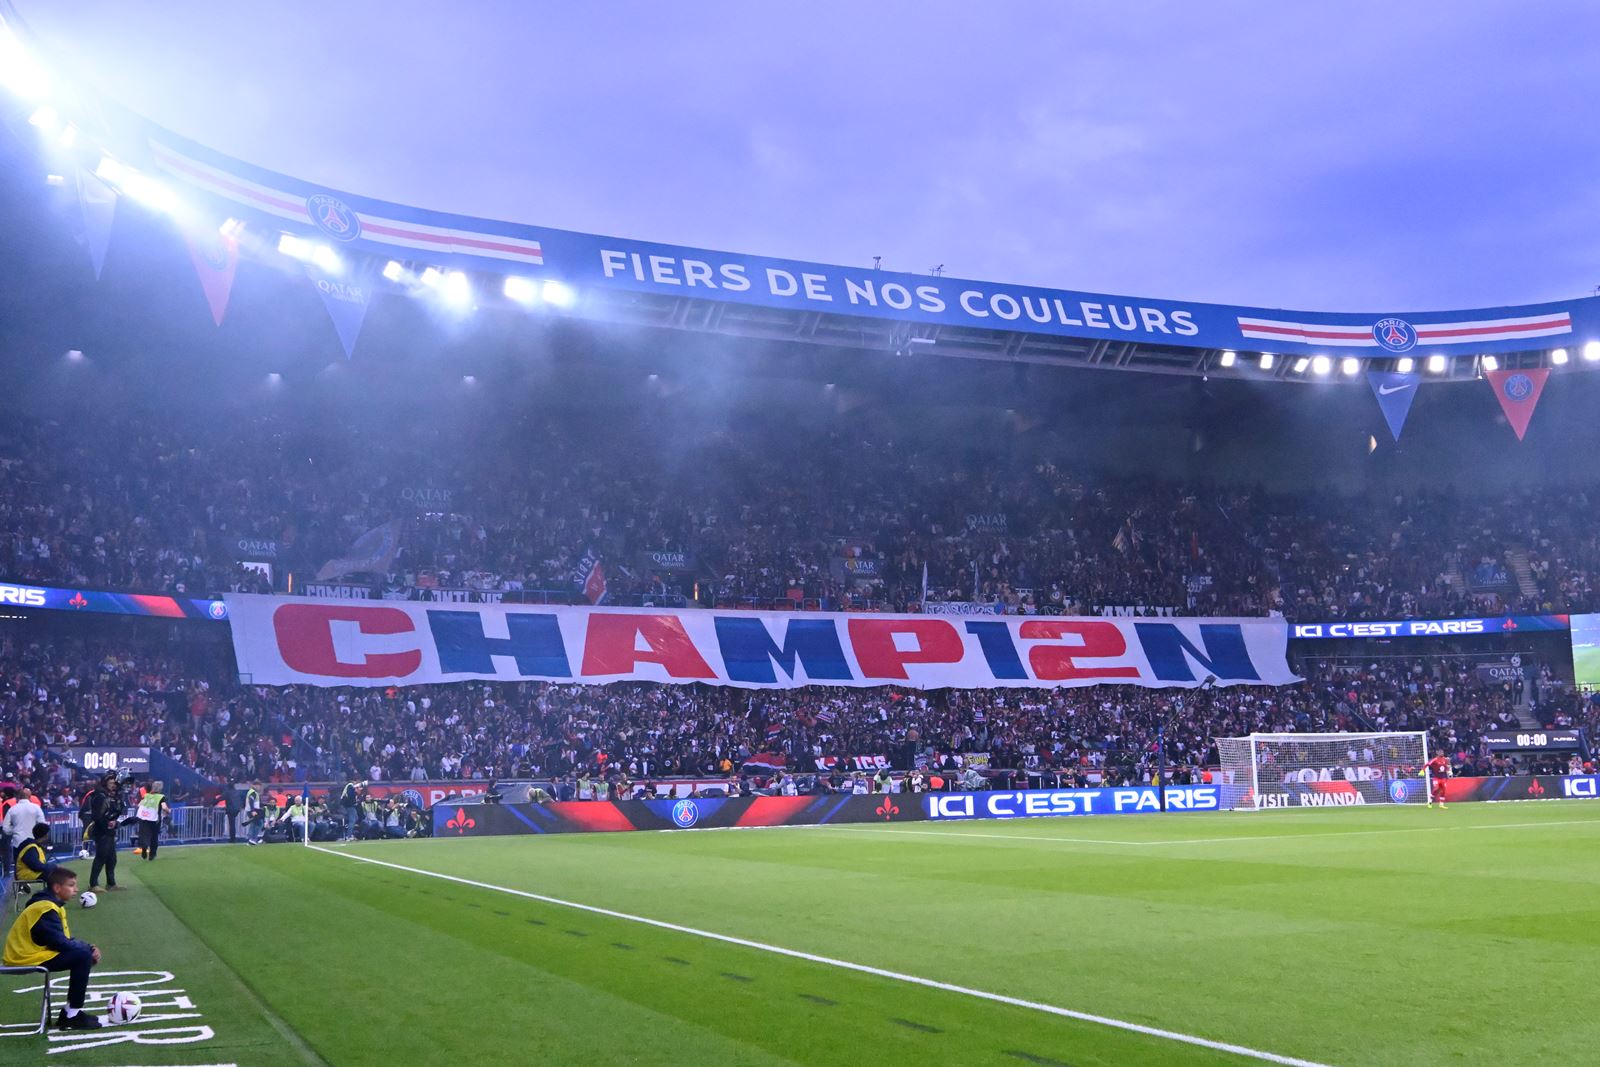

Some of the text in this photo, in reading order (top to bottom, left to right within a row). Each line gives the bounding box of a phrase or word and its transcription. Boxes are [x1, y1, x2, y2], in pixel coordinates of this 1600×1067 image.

[318, 279, 363, 298] QATAR
[600, 249, 1199, 336] FIERS DE NOS COULEURS
[401, 487, 452, 501] QATAR
[238, 539, 276, 550] QATAR
[652, 552, 685, 563] QATAR
[0, 585, 46, 606] RIS
[1295, 620, 1483, 637] ICI C'EST PARIS
[1490, 667, 1524, 678] QATAR
[1517, 734, 1547, 746] 00:00
[84, 752, 117, 769] 00:00
[1564, 778, 1596, 797] ICI
[930, 788, 1217, 818] ICI C'EST PARIS
[1252, 791, 1366, 809] VISIT RWANDA
